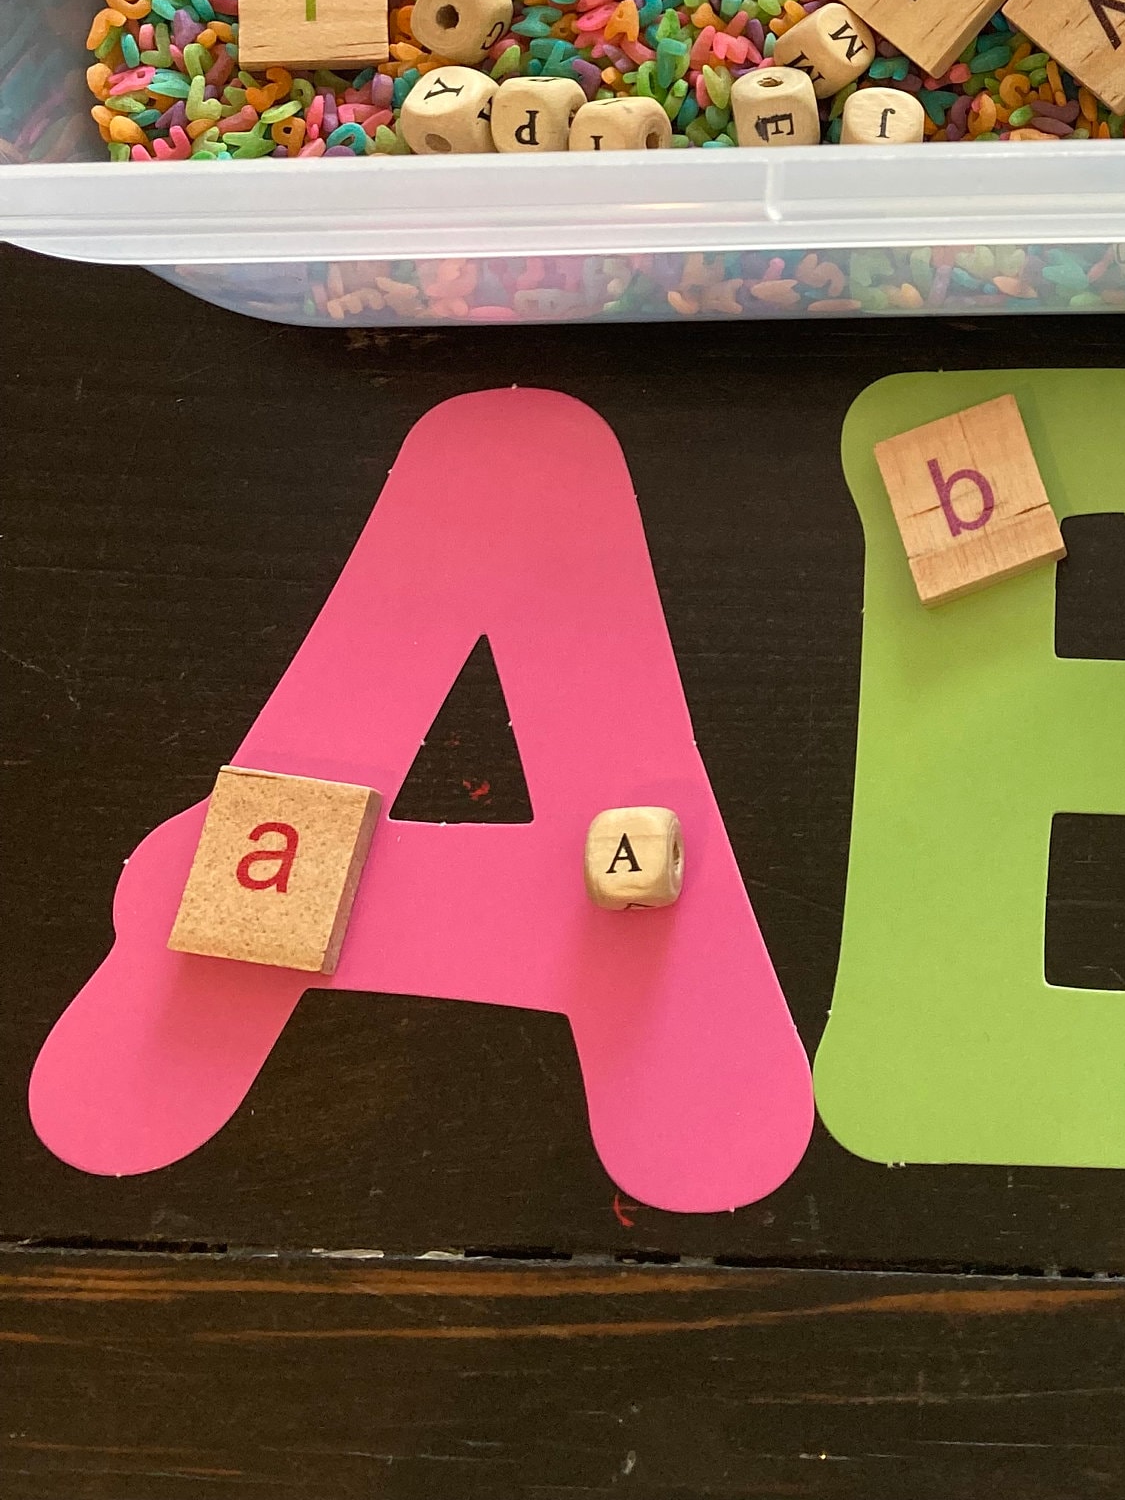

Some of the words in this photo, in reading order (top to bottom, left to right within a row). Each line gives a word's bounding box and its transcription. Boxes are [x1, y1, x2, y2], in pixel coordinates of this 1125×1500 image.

[926, 458, 995, 538] b
[28, 385, 815, 1215] A
[234, 820, 303, 894] a
[605, 832, 643, 874] A
